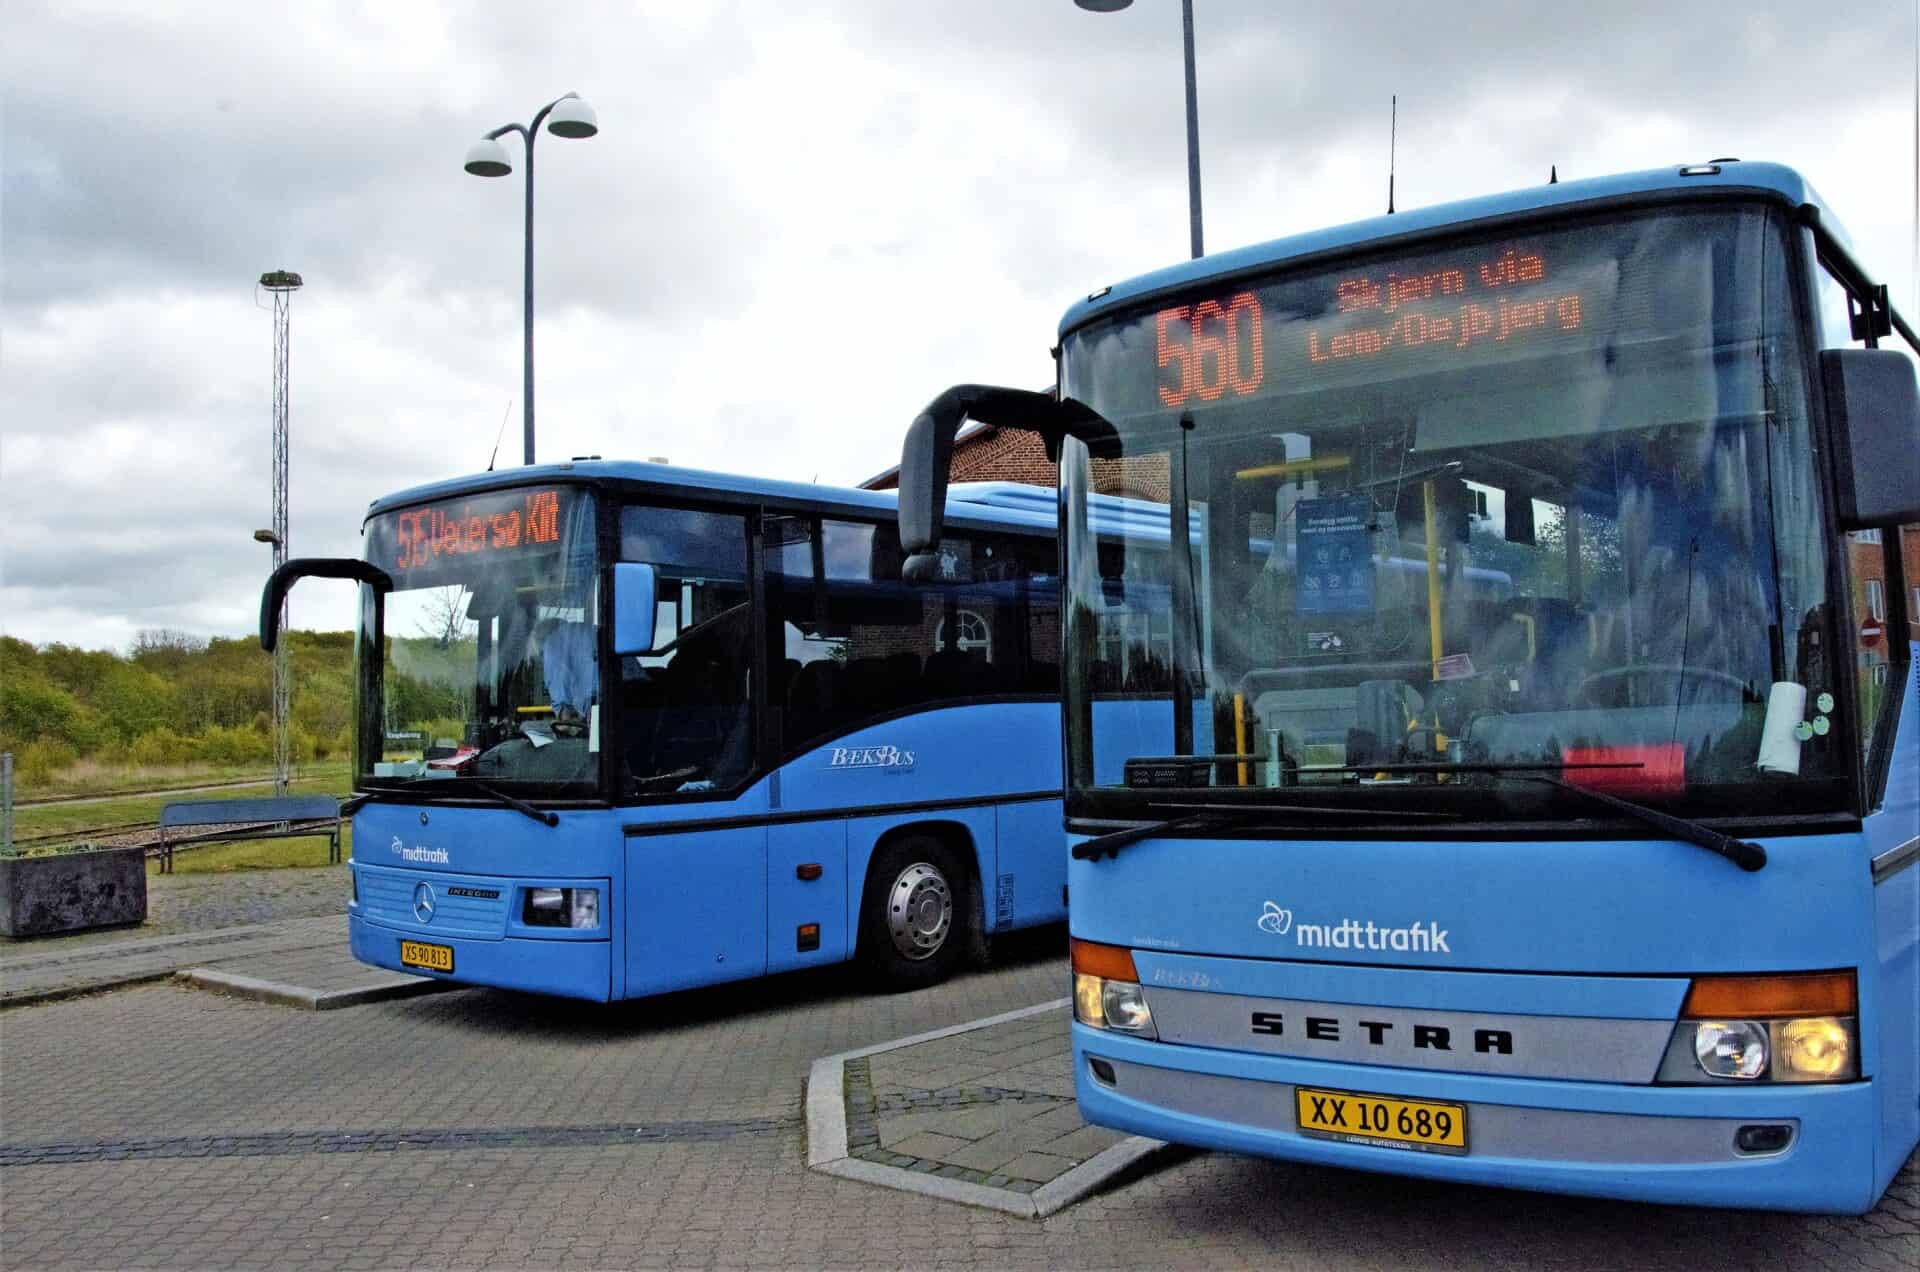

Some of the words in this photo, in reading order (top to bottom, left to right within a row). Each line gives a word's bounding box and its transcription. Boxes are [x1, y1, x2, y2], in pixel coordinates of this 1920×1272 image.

[1337, 270, 1464, 314] Skjern
[1480, 250, 1543, 288] via
[1157, 291, 1264, 407] 560
[1310, 295, 1581, 362] Lem/Dejbjerg
[402, 846, 449, 865] midttrafik
[405, 944, 417, 962] XS
[418, 946, 429, 964] 90
[430, 948, 448, 967] 813
[1296, 918, 1451, 953] midttrafik
[1251, 1011, 1514, 1056] SETRA
[1310, 1095, 1348, 1128] XX
[1357, 1102, 1390, 1133] 10
[1397, 1106, 1452, 1141] 689
